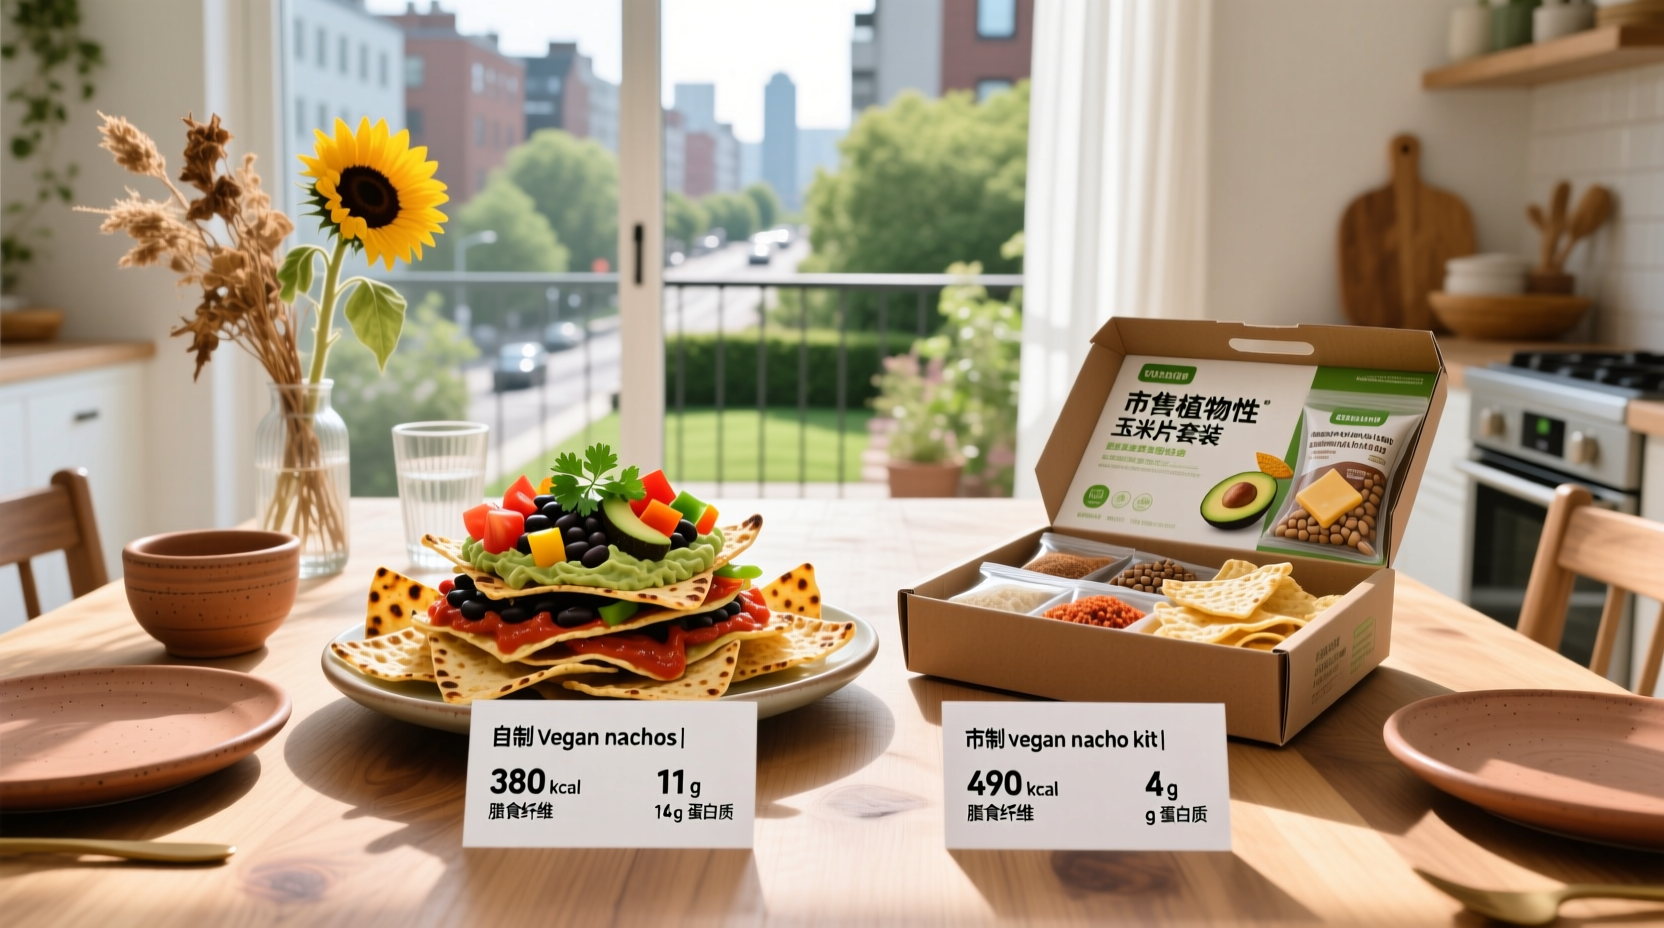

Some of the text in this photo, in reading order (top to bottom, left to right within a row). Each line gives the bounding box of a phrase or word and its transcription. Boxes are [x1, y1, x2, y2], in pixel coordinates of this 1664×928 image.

[1124, 390, 1260, 424] 市售植物性
[493, 724, 534, 748] 自制
[538, 728, 599, 751] Vegan
[604, 726, 678, 747] nachos
[965, 727, 1005, 750] 市制
[1008, 733, 1066, 753] vegan
[1071, 729, 1129, 749] nacho
[489, 767, 581, 795] 380 kcal
[657, 768, 701, 799] 11 g
[966, 769, 1059, 797] 490 kcal
[1145, 770, 1178, 801] 4 g
[687, 802, 734, 821] 蛋白质
[1145, 810, 1156, 826] g
